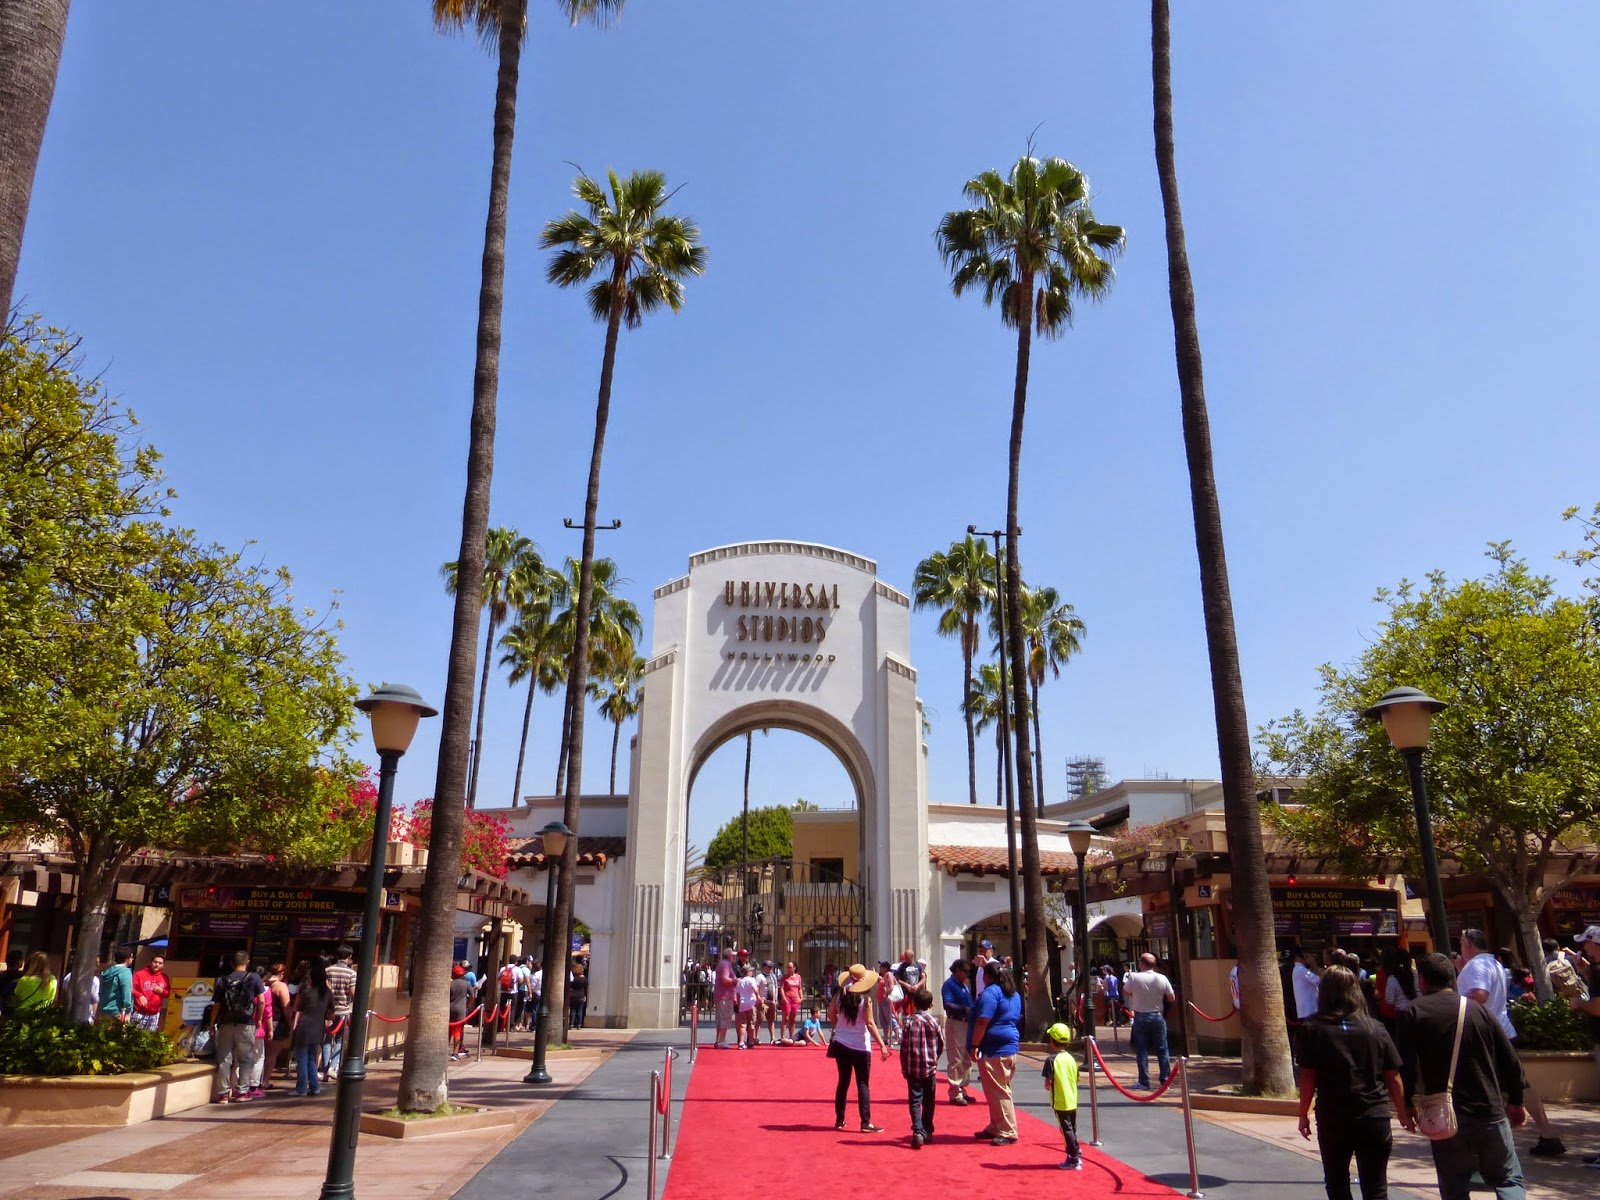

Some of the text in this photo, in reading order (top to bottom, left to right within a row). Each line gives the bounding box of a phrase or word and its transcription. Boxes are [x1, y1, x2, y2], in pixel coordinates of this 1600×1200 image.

[725, 580, 840, 609] UNIVERSAL
[738, 615, 826, 642] STUDIOS
[727, 652, 836, 662] HOLLYWOOD
[1144, 861, 1166, 871] 4493
[251, 890, 313, 900] BUY A DAY, GT
[1286, 891, 1303, 899] BUY
[1303, 891, 1309, 899] A
[1311, 891, 1327, 900] DAY,
[230, 899, 335, 910] THE REST OF 2015 FREE!
[1285, 900, 1306, 908] REST
[1320, 900, 1339, 908] 2015
[1341, 900, 1364, 909] FREE!
